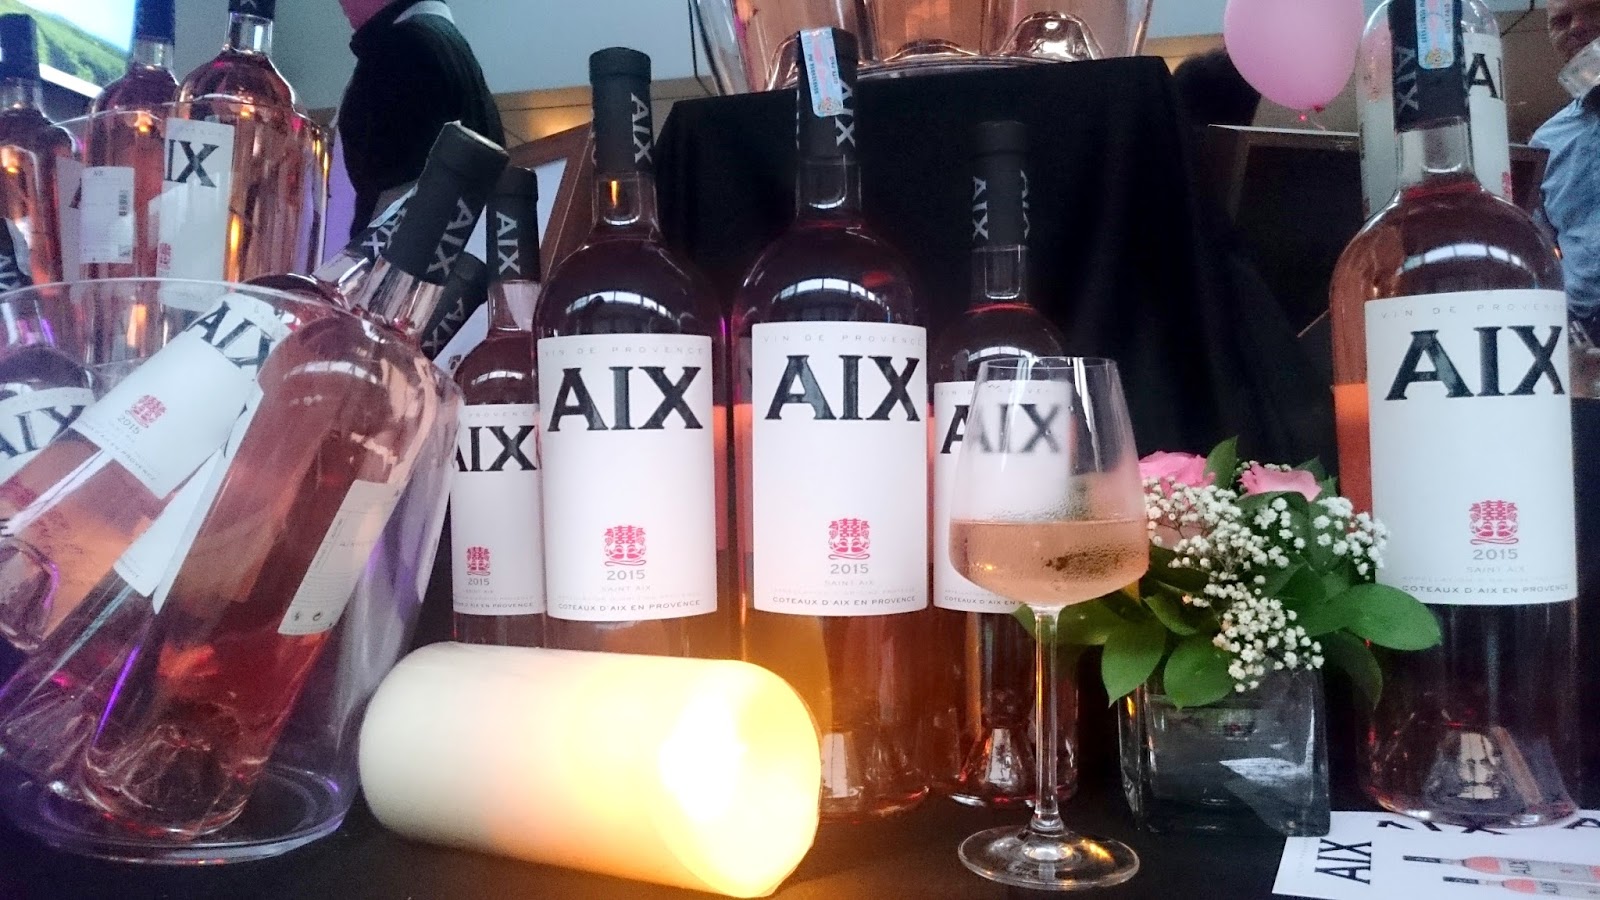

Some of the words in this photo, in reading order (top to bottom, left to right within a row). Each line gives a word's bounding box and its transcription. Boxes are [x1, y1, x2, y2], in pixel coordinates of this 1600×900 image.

[1394, 46, 1419, 112] AIX
[630, 91, 653, 164] AIX
[971, 175, 989, 240] AIX
[426, 197, 475, 278] AIX
[495, 210, 522, 276] AIX
[1432, 306, 1457, 315] DE
[184, 300, 276, 375] AIX
[804, 334, 825, 342] DE
[841, 335, 923, 346] PROVENCE
[577, 347, 594, 355] DE
[1384, 325, 1566, 401] AIX
[763, 354, 921, 421] AIX
[547, 365, 704, 432] AIX
[117, 414, 141, 435] 2015
[940, 403, 1062, 455] AIX
[1471, 548, 1519, 561] 2015
[606, 569, 646, 581] 2015
[829, 562, 870, 575] 2015
[1465, 565, 1498, 574] SAINT
[1505, 565, 1526, 574] AIX
[467, 578, 490, 586] 2015
[1402, 585, 1460, 594] COTEAUX
[1522, 583, 1569, 593] PROVENCE
[558, 603, 596, 612] COTEAUX
[599, 604, 627, 612] D'AIX
[648, 600, 701, 610] PROVENCE
[772, 596, 818, 606] COTEAUX
[871, 595, 917, 605] PROVENCE
[944, 595, 977, 604] COTEAUX
[1313, 837, 1372, 885] AIX
